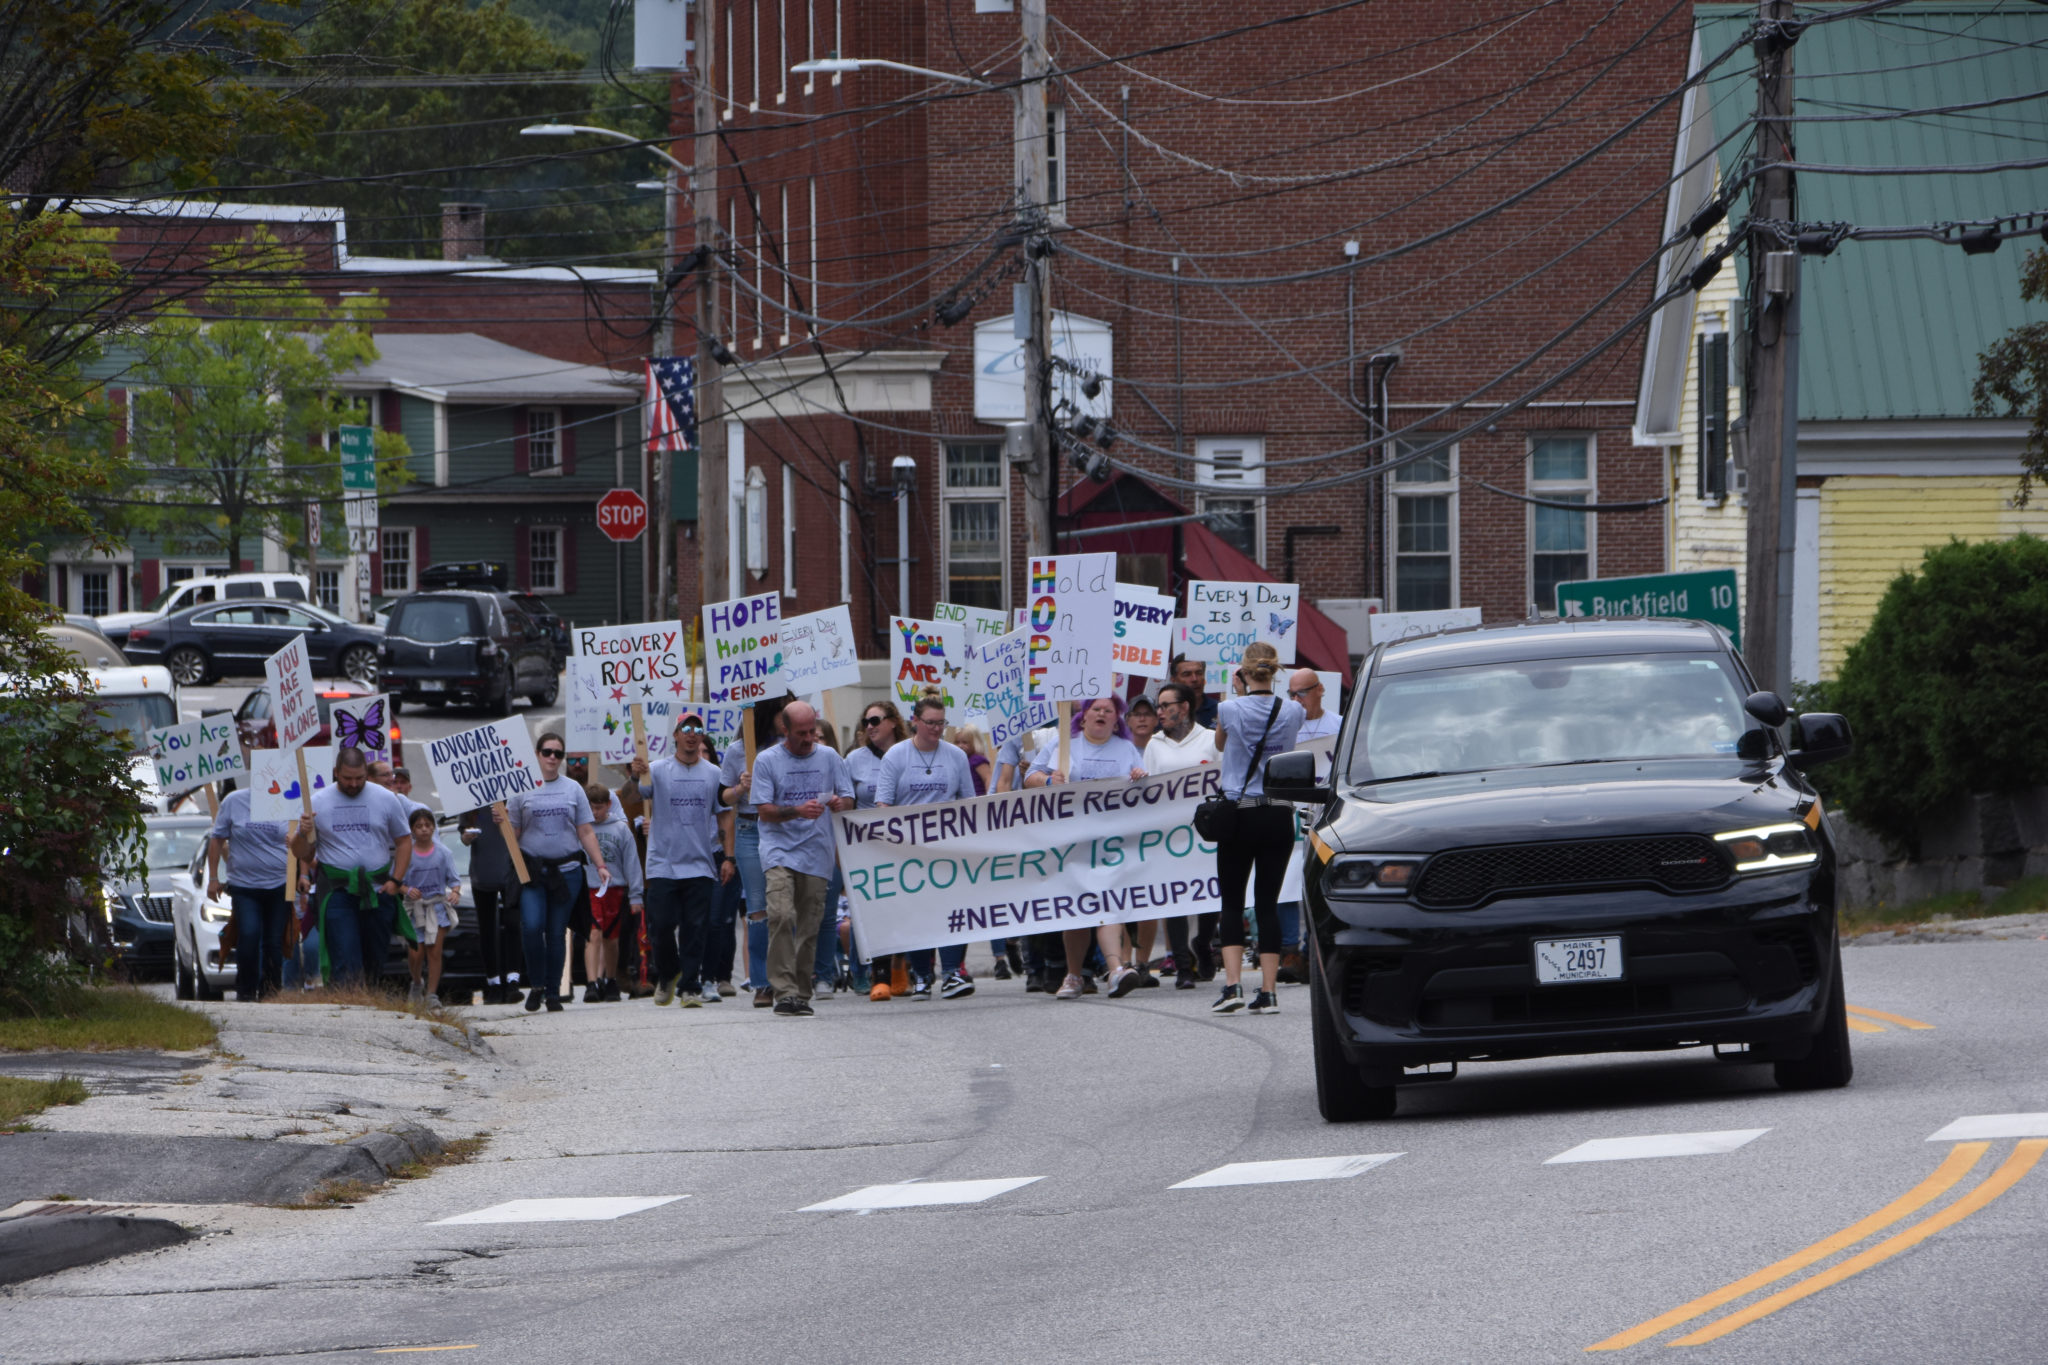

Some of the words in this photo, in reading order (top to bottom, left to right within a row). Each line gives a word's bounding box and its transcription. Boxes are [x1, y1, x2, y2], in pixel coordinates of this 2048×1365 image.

[601, 505, 644, 525] STOP
[359, 560, 370, 581] 26
[1032, 555, 1109, 594] Hold
[1256, 585, 1291, 610] Day
[1593, 589, 1688, 617] Buckfield
[1710, 585, 1732, 609] 10
[711, 595, 777, 634] HOPE
[935, 604, 967, 621] END
[976, 618, 1004, 636] THE
[1031, 595, 1073, 633] On
[1114, 600, 1173, 626] OVERY
[581, 631, 677, 656] RECOVERY
[760, 633, 778, 647] ON
[1114, 620, 1126, 638] S
[1189, 624, 1257, 647] Second
[275, 645, 299, 678] YOU
[1029, 634, 1088, 665] Pain
[1112, 643, 1163, 666] SIBLE
[601, 653, 679, 686] ROCKS
[720, 657, 767, 684] PAIN
[898, 657, 942, 684] Are
[1029, 667, 1100, 701] Ends
[280, 672, 299, 700] ARE
[730, 682, 765, 701] ENDS
[281, 688, 303, 720] NOT
[200, 722, 231, 744] Are
[283, 705, 318, 748] ALONE
[159, 762, 192, 786] Not
[198, 753, 243, 778] Alone
[468, 766, 536, 807] SUPPORT
[842, 803, 977, 845] WESTERN
[987, 791, 1074, 831] MAINE
[1083, 769, 1221, 815] RECOVER
[849, 843, 1077, 901] RECOVERY
[1090, 835, 1124, 869] IS
[948, 876, 1221, 933] #NEVERGIVEUP20
[1567, 948, 1605, 971] 2497
[1559, 971, 1602, 980] MUNICIPAL
